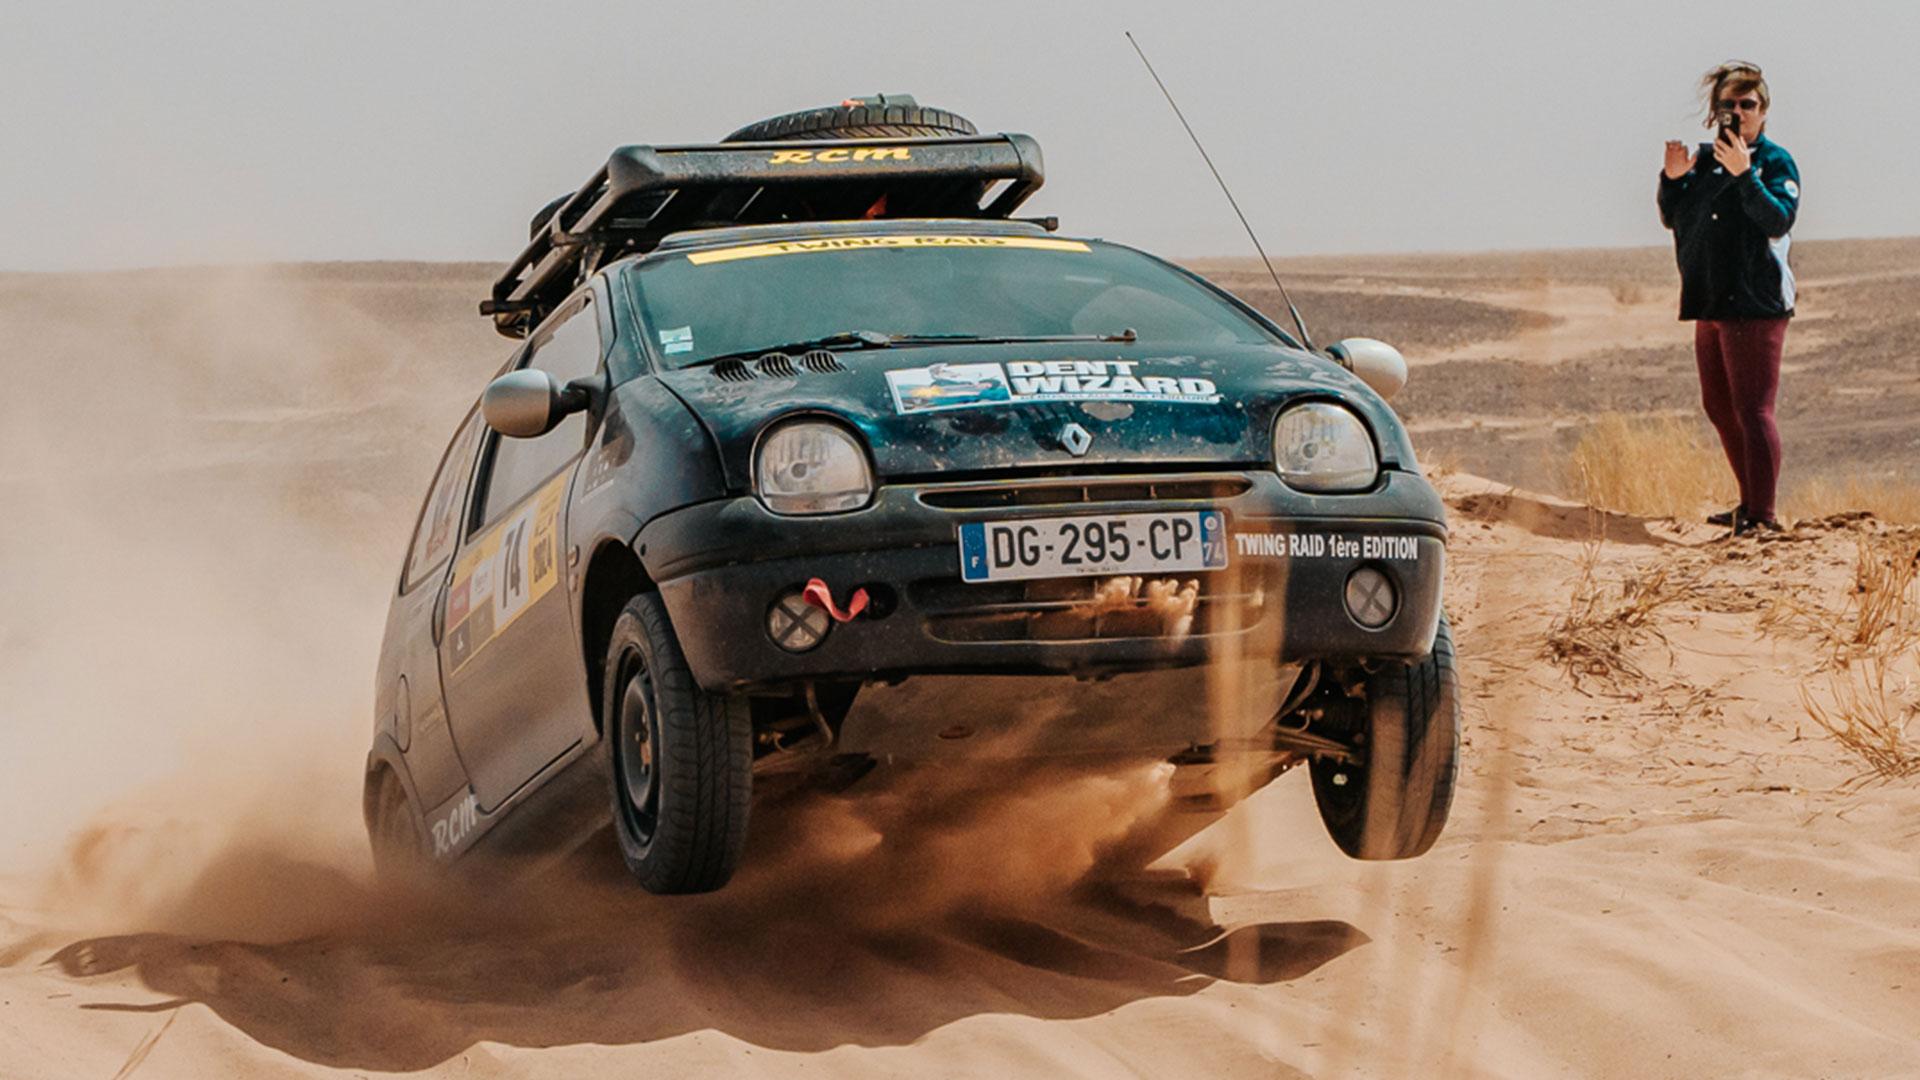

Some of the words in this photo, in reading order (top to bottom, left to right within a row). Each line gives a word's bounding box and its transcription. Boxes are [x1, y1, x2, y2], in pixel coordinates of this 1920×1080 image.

[778, 237, 898, 252] TWING
[1009, 360, 1138, 377] DENT
[1010, 376, 1217, 395] WIZARD
[992, 518, 1193, 568] DG-295-CP
[1203, 542, 1224, 562] 74
[1235, 534, 1285, 556] TWING
[1289, 534, 1325, 557] RAID
[1329, 535, 1360, 557] 1ère
[1363, 536, 1418, 560] EDITION
[971, 556, 979, 568] F
